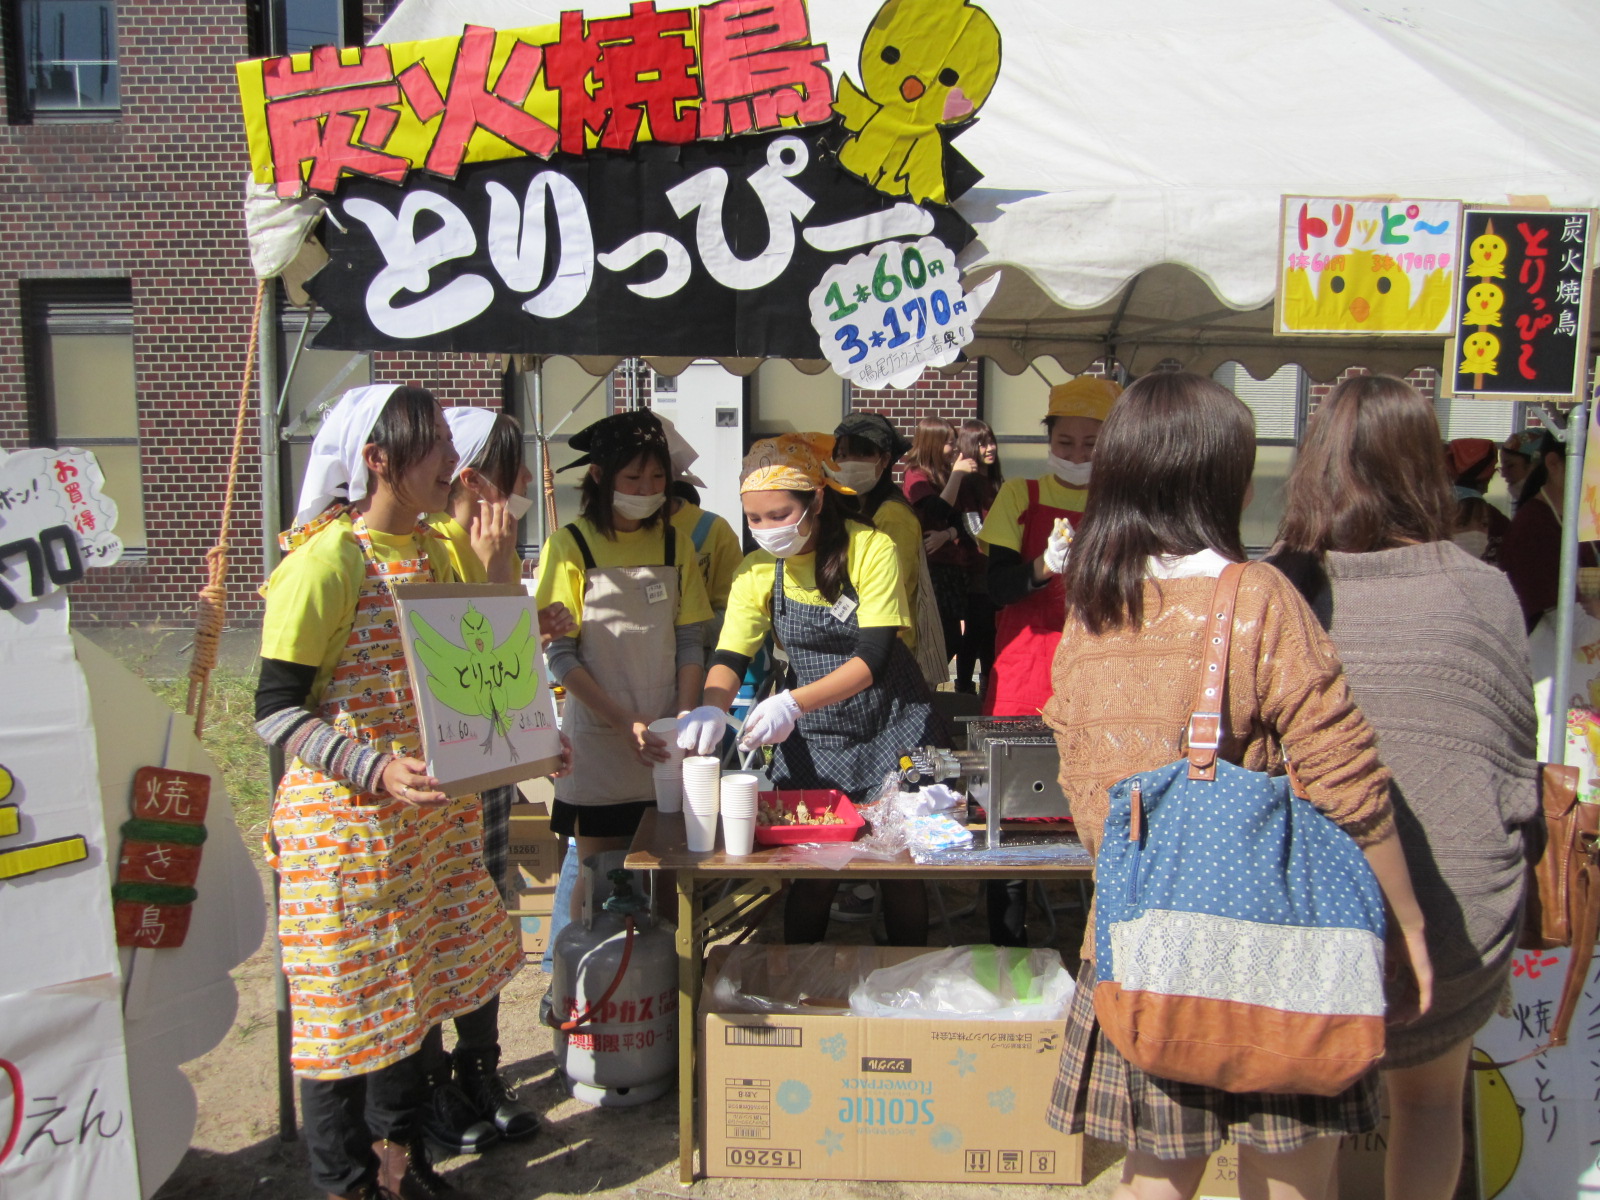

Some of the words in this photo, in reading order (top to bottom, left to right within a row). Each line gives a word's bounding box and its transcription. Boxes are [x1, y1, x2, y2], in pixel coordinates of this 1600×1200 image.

[262, 0, 835, 199] 炭火焼鳥
[343, 135, 935, 339] とりっぴー
[1553, 215, 1584, 337] 炭火焼鳥
[134, 776, 192, 945] 焼き鳥
[867, 1059, 906, 1072] シングル
[731, 1149, 795, 1166] 15260
[1003, 1160, 1018, 1171] 12
[1038, 1156, 1048, 1171] 8
